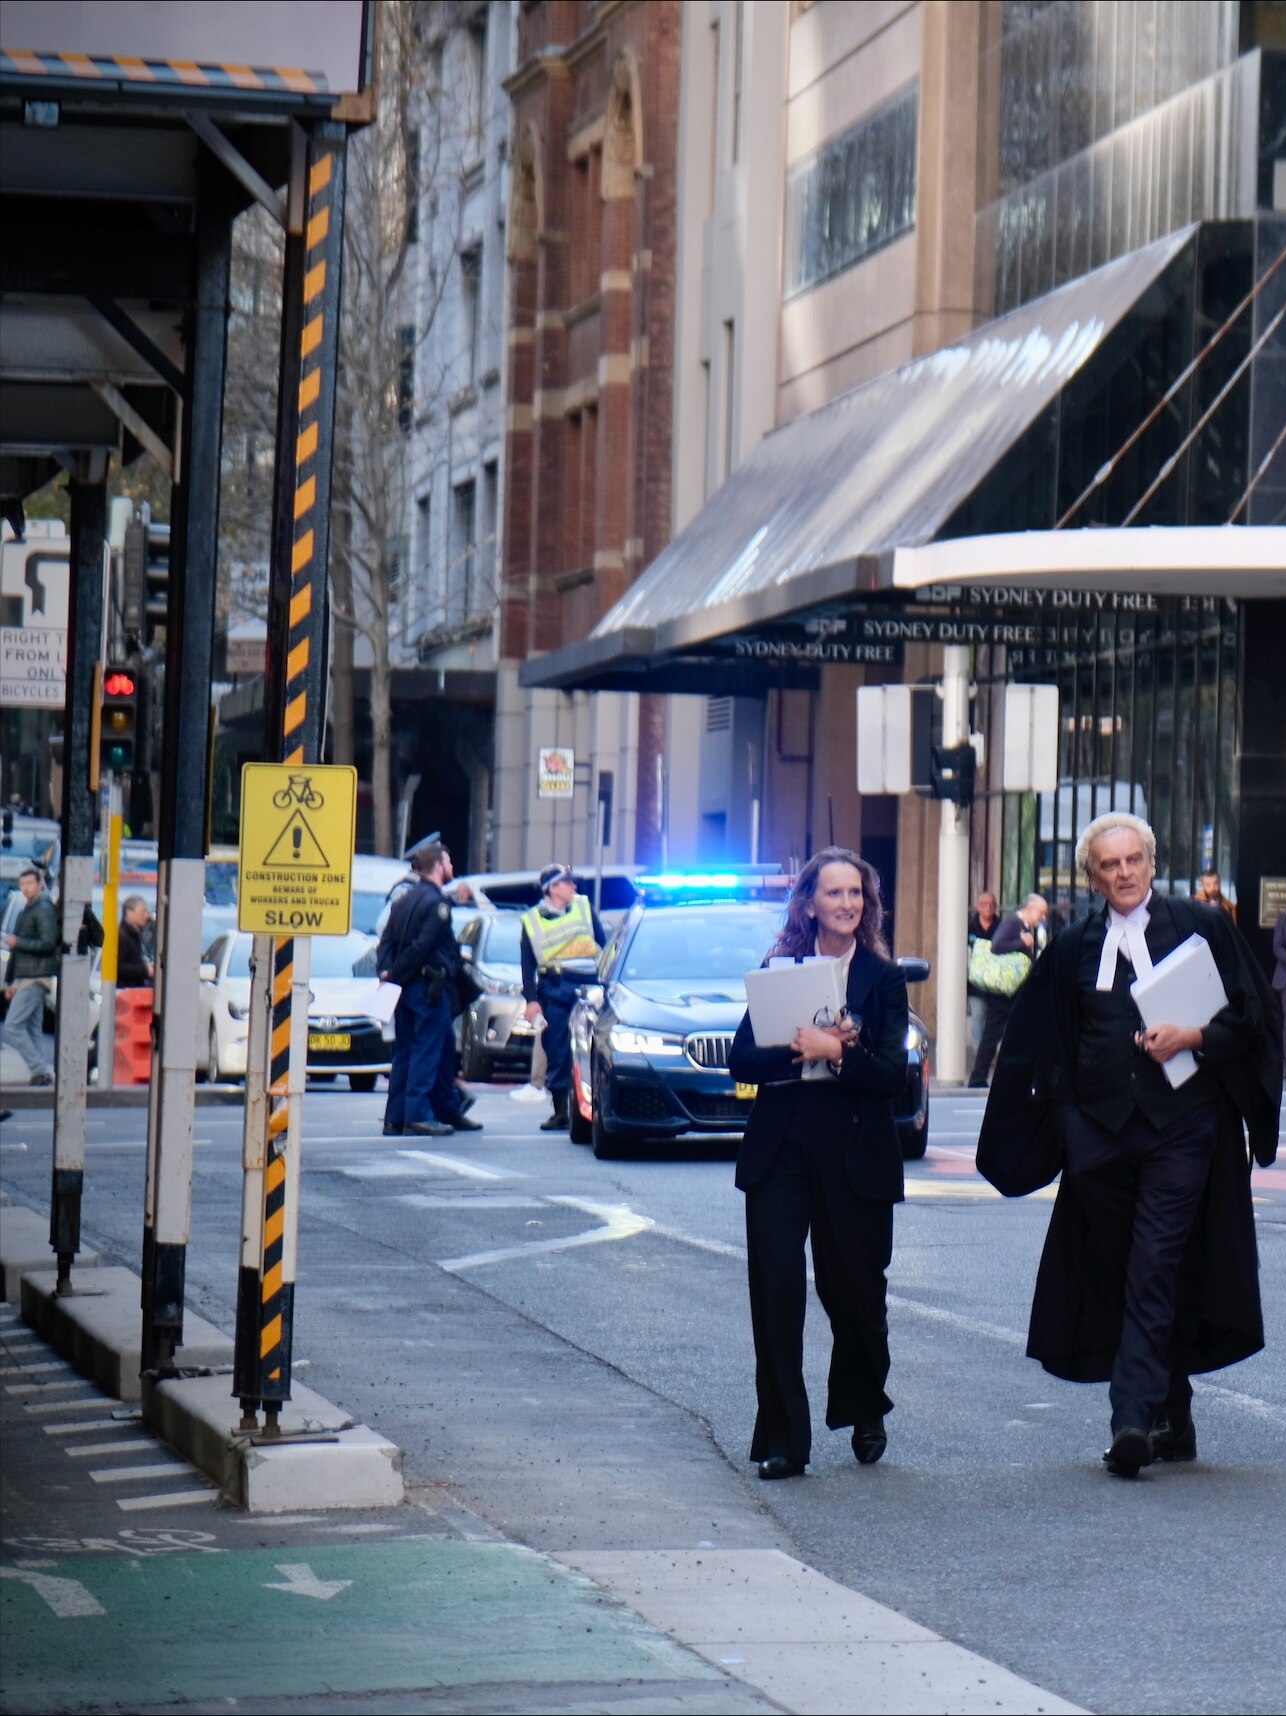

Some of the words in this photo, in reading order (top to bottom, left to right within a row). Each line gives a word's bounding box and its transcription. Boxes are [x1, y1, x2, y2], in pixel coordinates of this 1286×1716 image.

[969, 585, 1047, 606] SYDNEY
[1052, 588, 1107, 608] DUTY
[1112, 592, 1158, 611] FREE
[3, 631, 49, 645] RIGHT
[863, 620, 935, 638] SYDNEY
[938, 622, 988, 641] DUTY
[993, 624, 1034, 643] FREE
[5, 648, 50, 661] FROM
[735, 640, 801, 658] SYDNEY
[806, 643, 851, 661] DUTY
[855, 644, 895, 662] FREE
[2, 683, 60, 698] BICYCLES
[245, 871, 318, 882] CONSTRUCTION
[321, 873, 346, 884] ZONE
[272, 885, 305, 894] BEWARE
[307, 886, 318, 895] OF
[250, 896, 288, 905] WORKERS
[290, 897, 307, 905] AND
[309, 898, 340, 907] TRUCKS
[264, 910, 323, 928] SLOW
